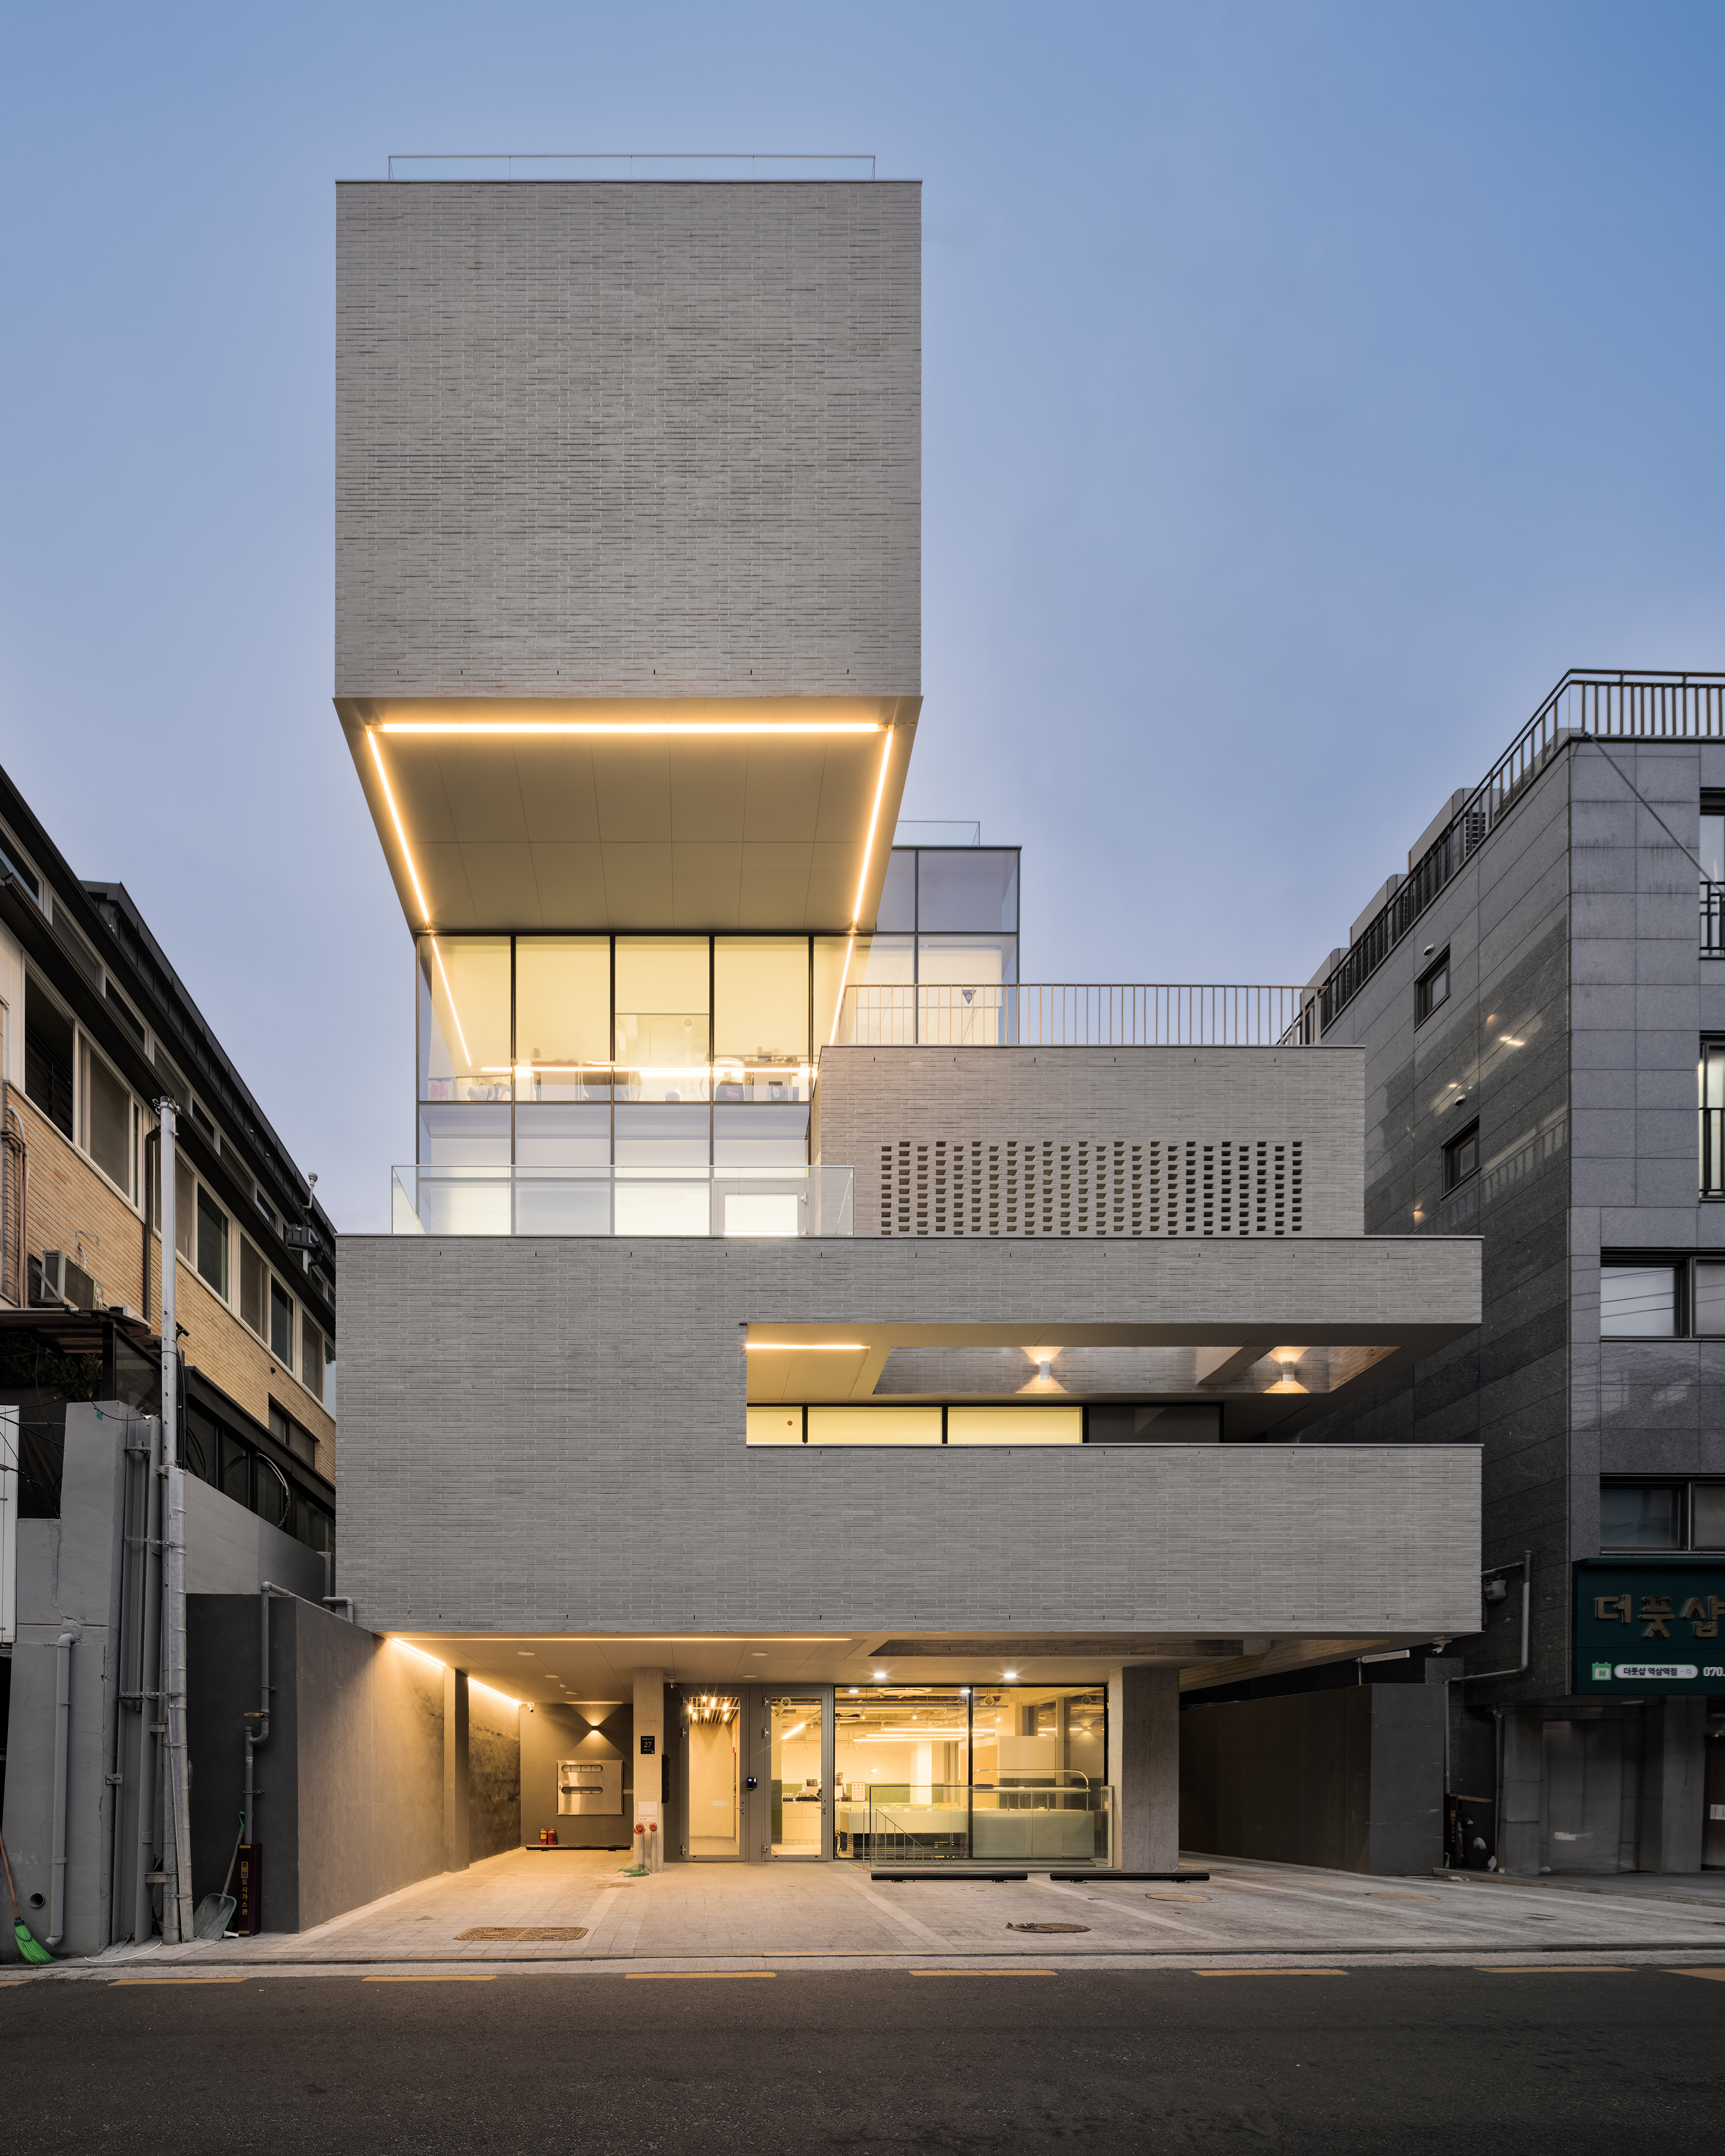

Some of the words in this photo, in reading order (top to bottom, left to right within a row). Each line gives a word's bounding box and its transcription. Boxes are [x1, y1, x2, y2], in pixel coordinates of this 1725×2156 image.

[1595, 1594, 1725, 1638] 더풋샵
[1623, 1667, 1646, 1675] 더풋샵
[1648, 1667, 1677, 1676] 역삼역점
[242, 1862, 248, 1878] 주의
